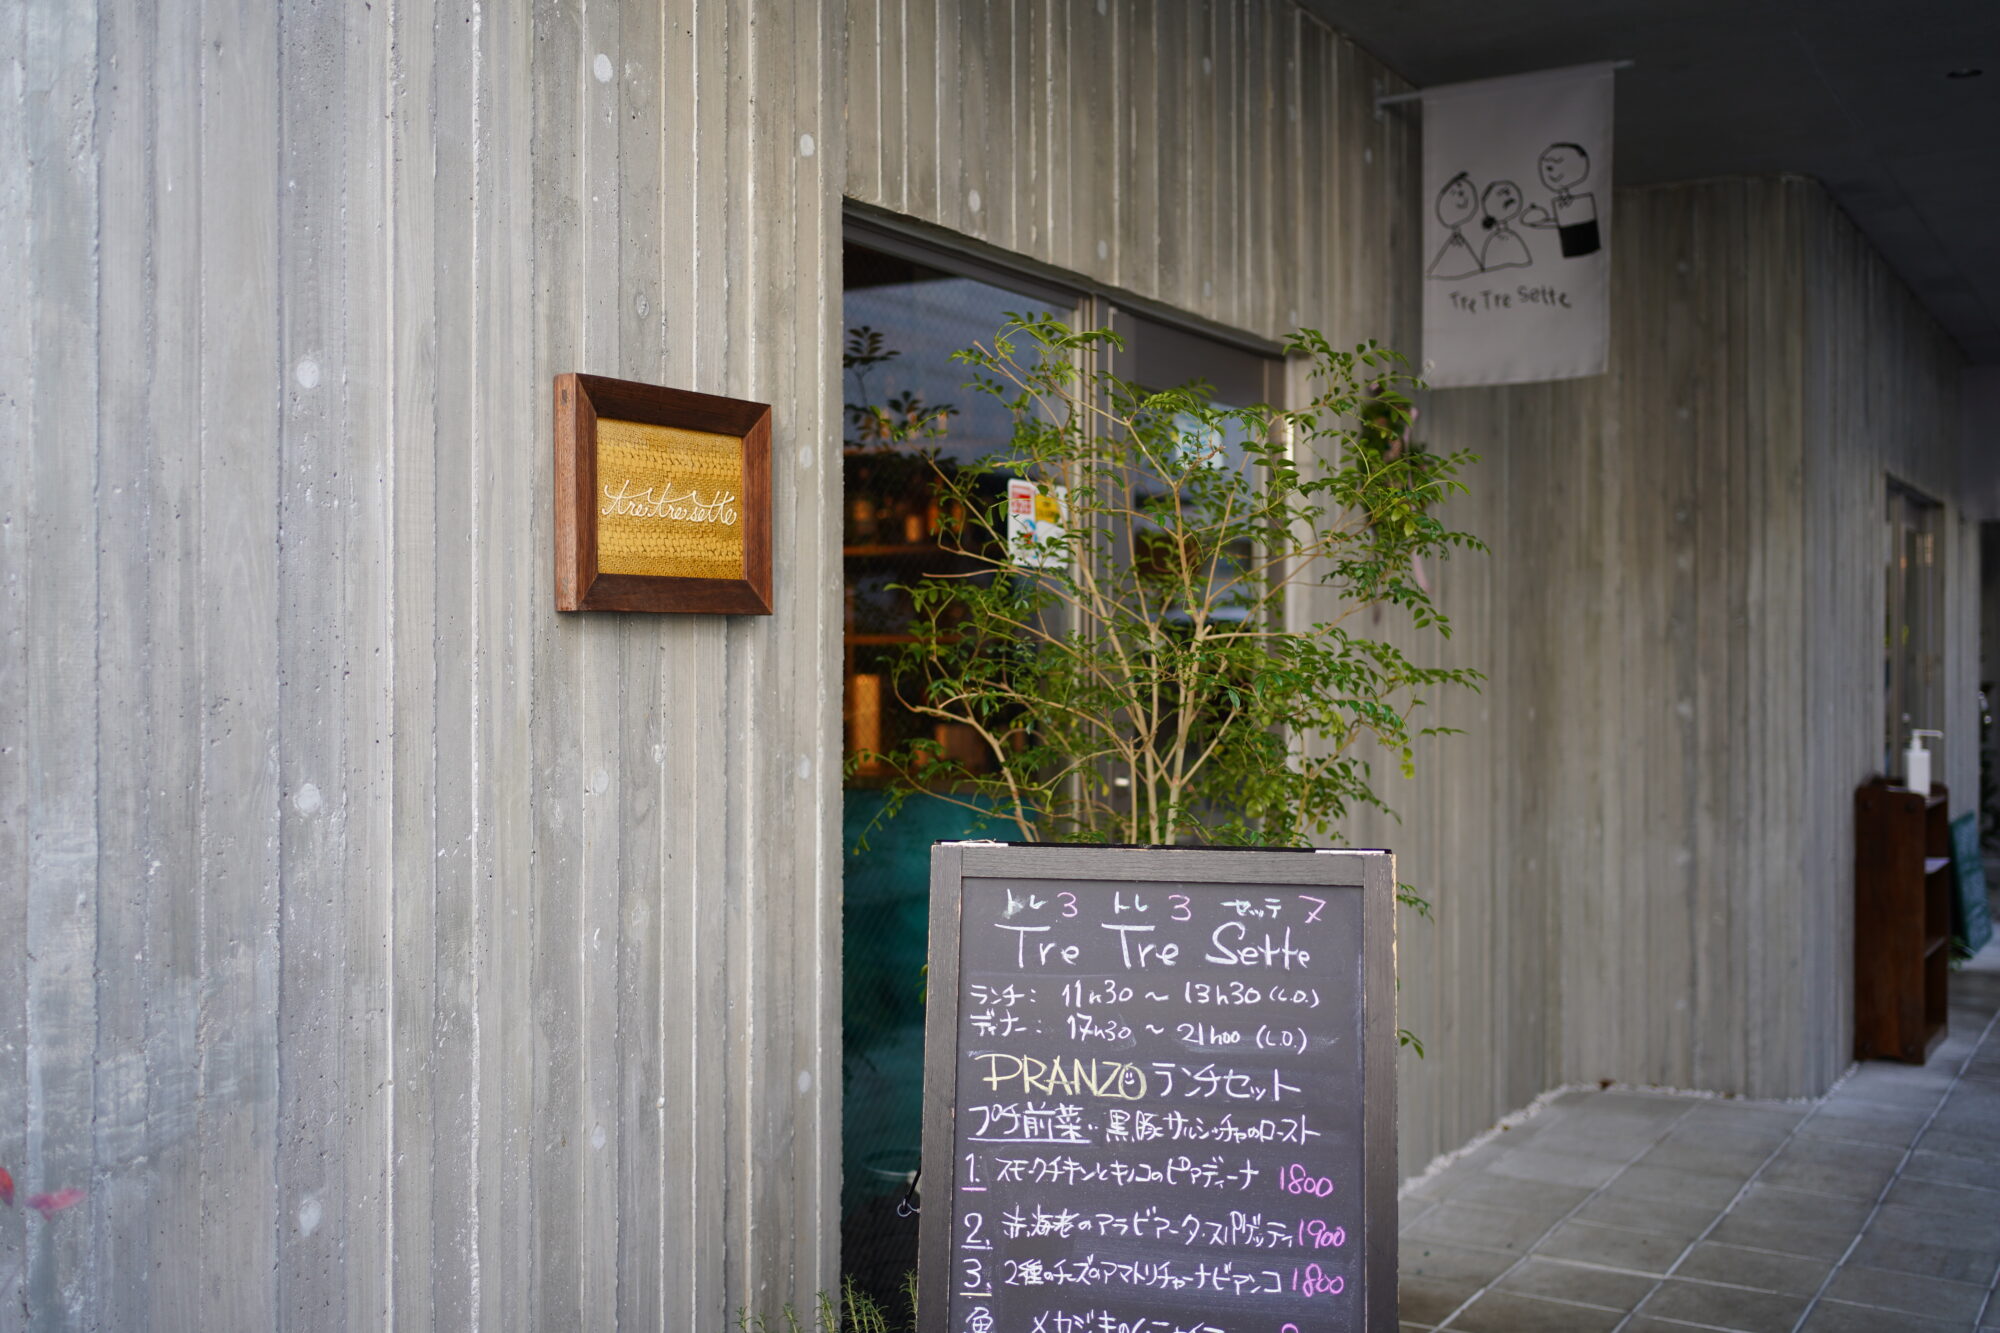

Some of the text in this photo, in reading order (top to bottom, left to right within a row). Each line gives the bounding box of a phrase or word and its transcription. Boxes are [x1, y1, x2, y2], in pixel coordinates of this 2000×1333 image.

[1057, 892, 1078, 917] 3
[1168, 895, 1192, 921] 3
[1298, 895, 1327, 924] 7
[994, 921, 1310, 970] Tre Tre Sette
[974, 1053, 1301, 1101] PRANZO ランチセット
[1279, 1164, 1334, 1198] 1800
[1299, 1219, 1346, 1249] 1900
[1292, 1263, 1345, 1297] 1800
